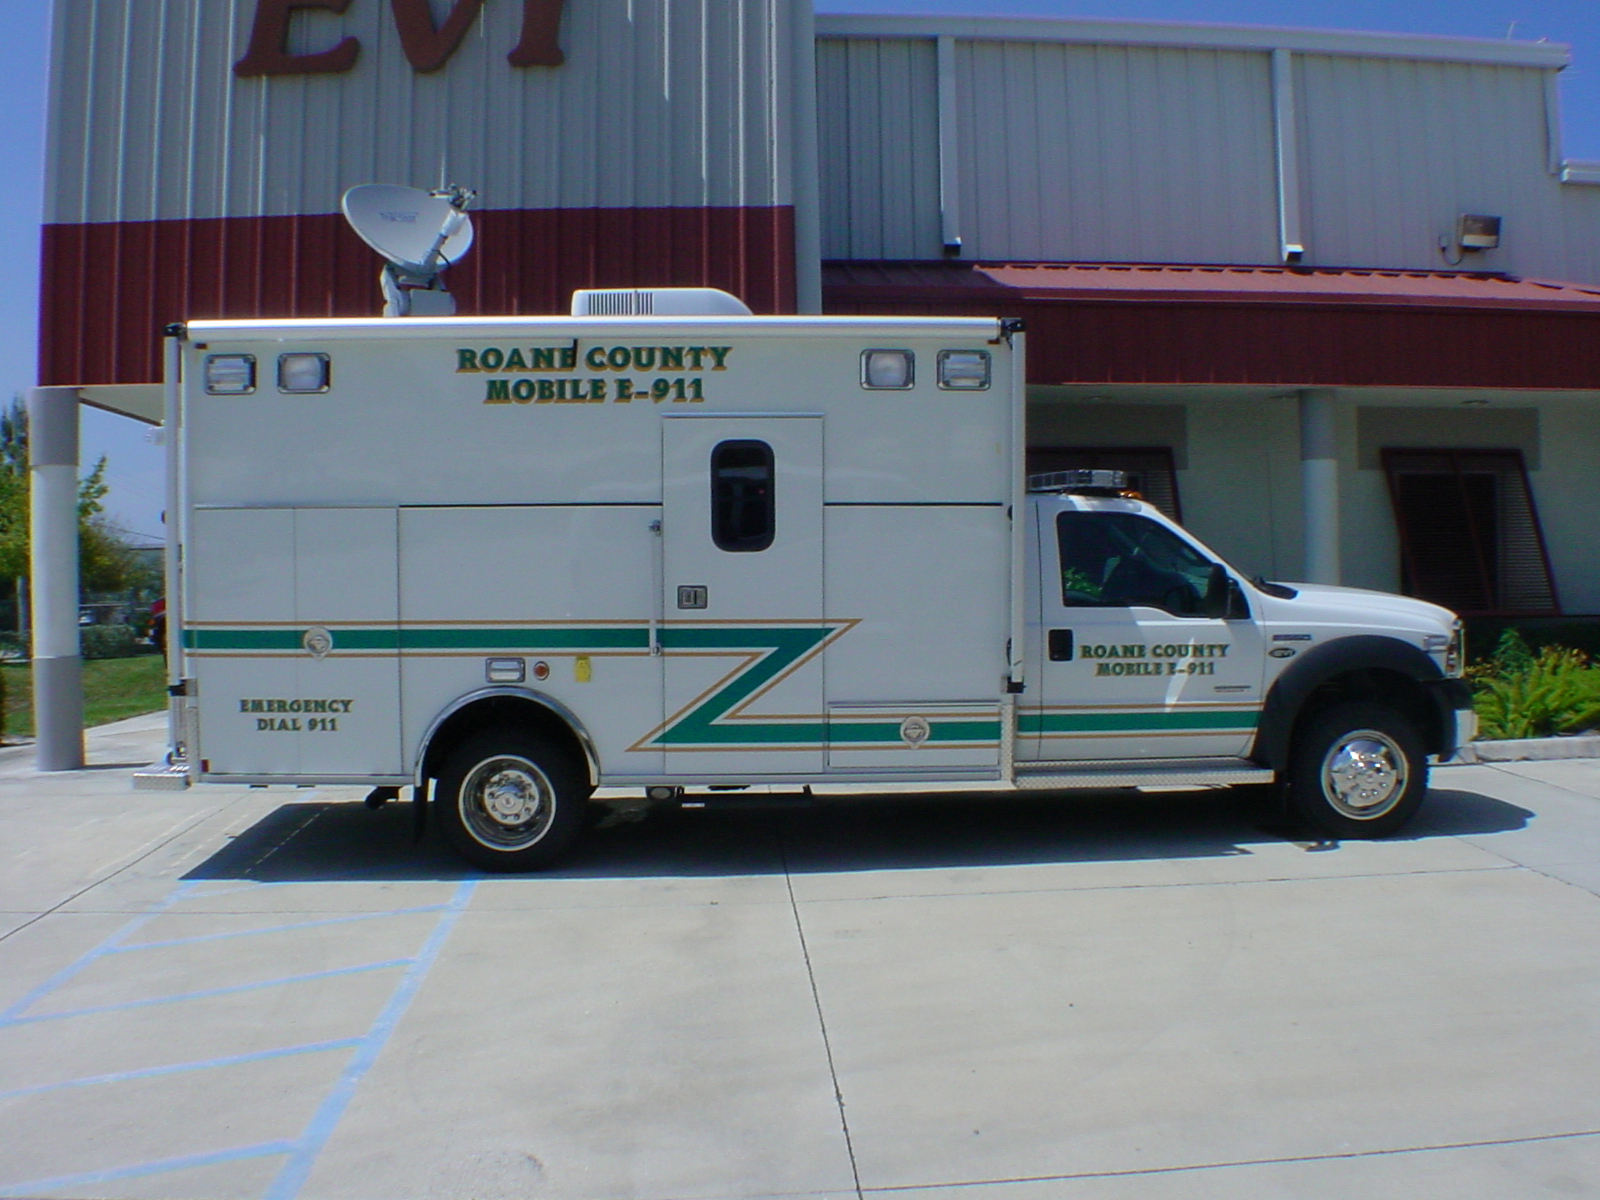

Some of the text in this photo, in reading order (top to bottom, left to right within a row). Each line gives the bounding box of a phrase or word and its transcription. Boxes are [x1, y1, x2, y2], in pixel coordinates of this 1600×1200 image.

[456, 346, 733, 373] ROANE COUNTY
[483, 377, 705, 404] MOBILE E-911
[1080, 643, 1230, 659] ROANE COUNTY
[1094, 661, 1216, 677] MOBILE E-911
[239, 699, 353, 714] EMERGENCY
[256, 717, 338, 732] DIAL 911
